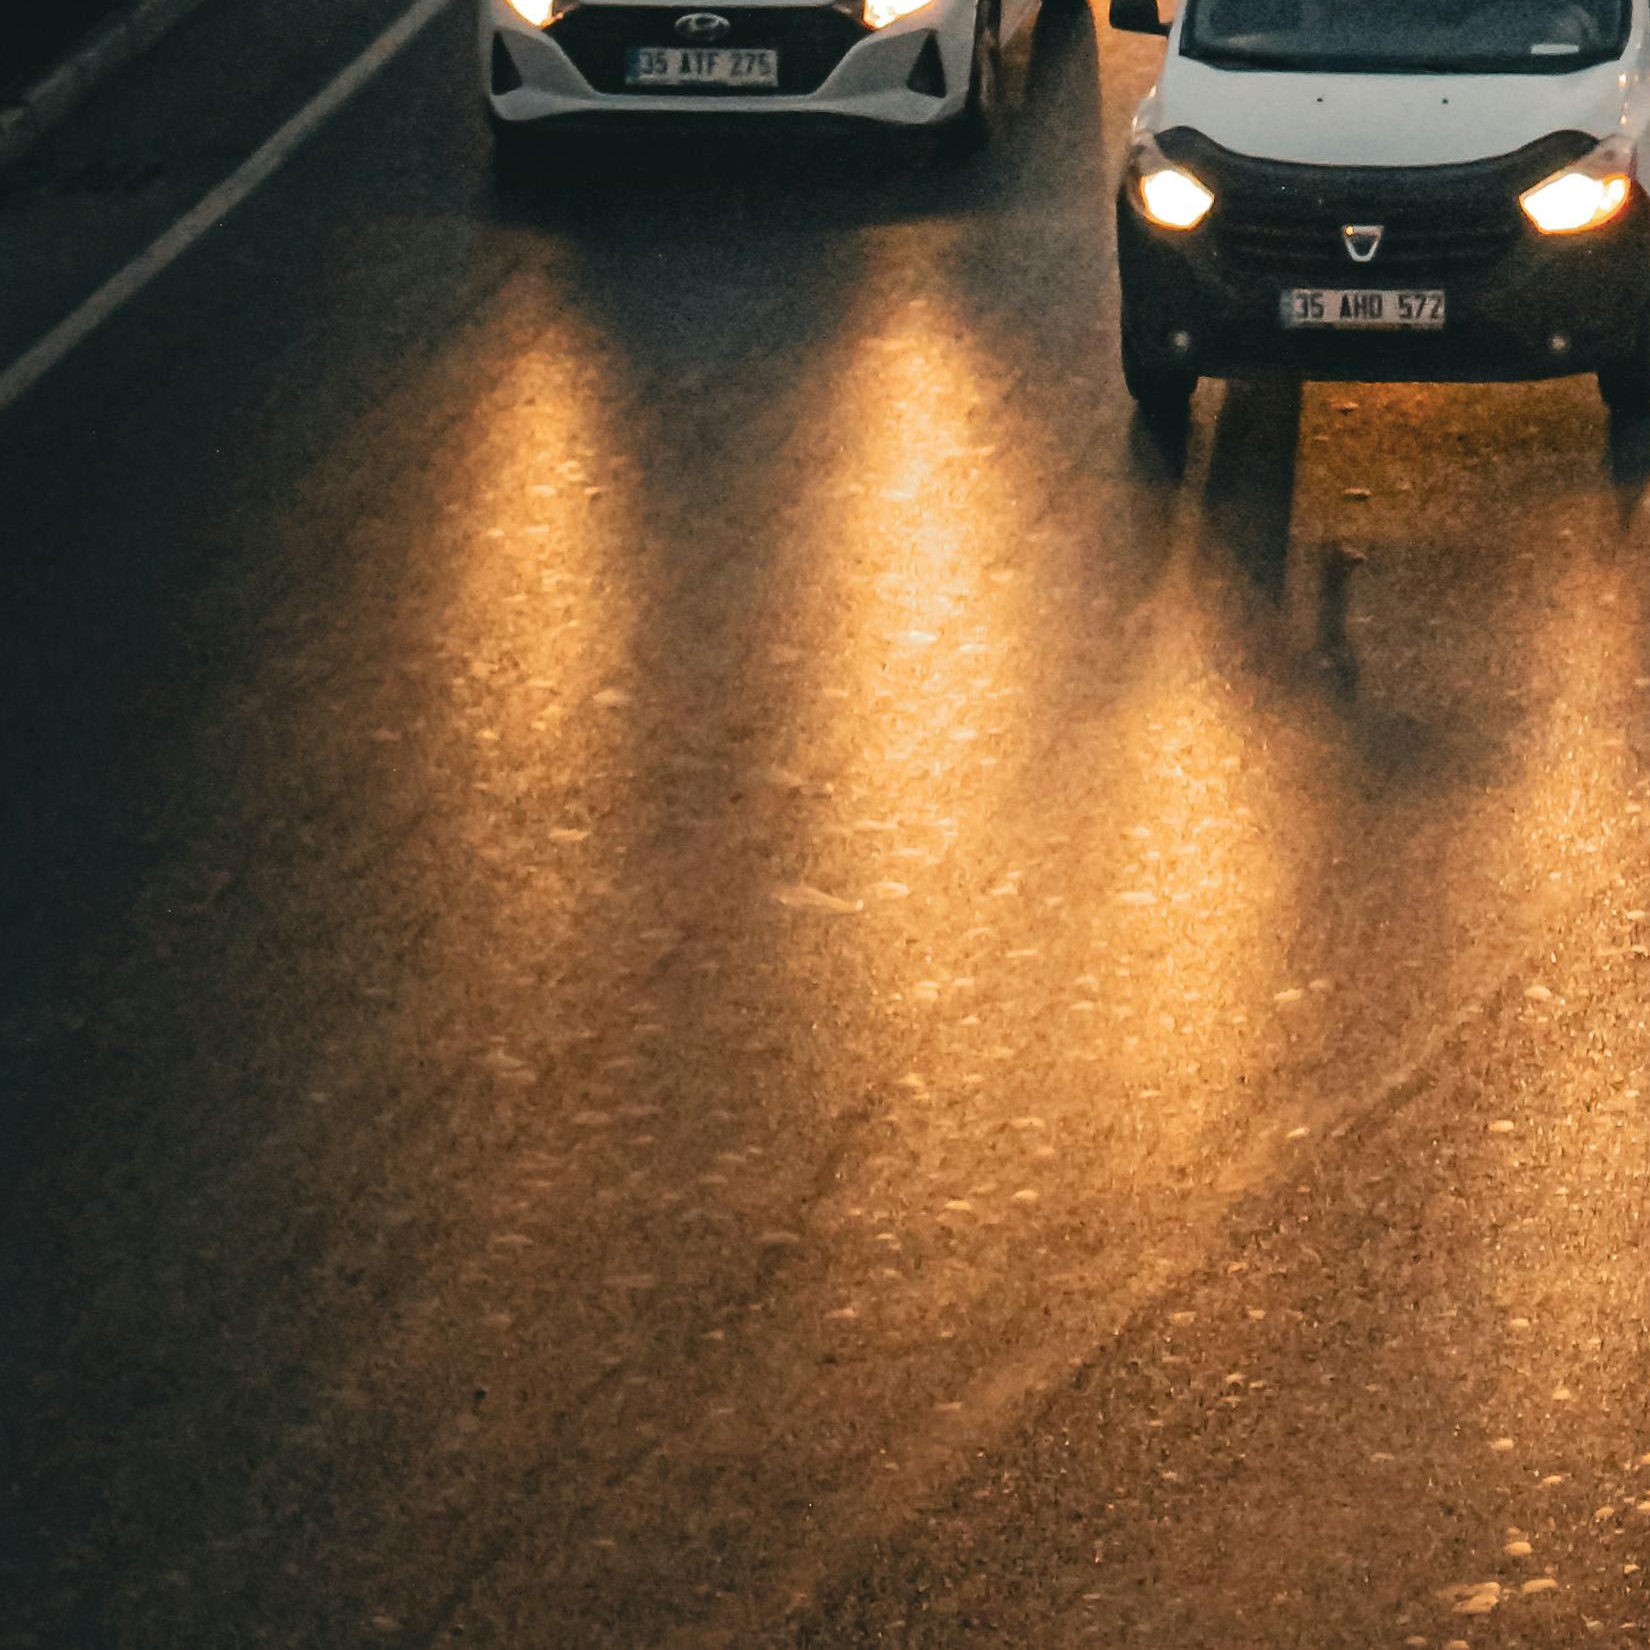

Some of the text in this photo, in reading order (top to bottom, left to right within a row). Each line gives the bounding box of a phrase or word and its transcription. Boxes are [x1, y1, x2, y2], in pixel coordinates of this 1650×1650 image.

[640, 51, 667, 75] 35
[1295, 293, 1324, 318] 35
[1398, 294, 1442, 320] 572
